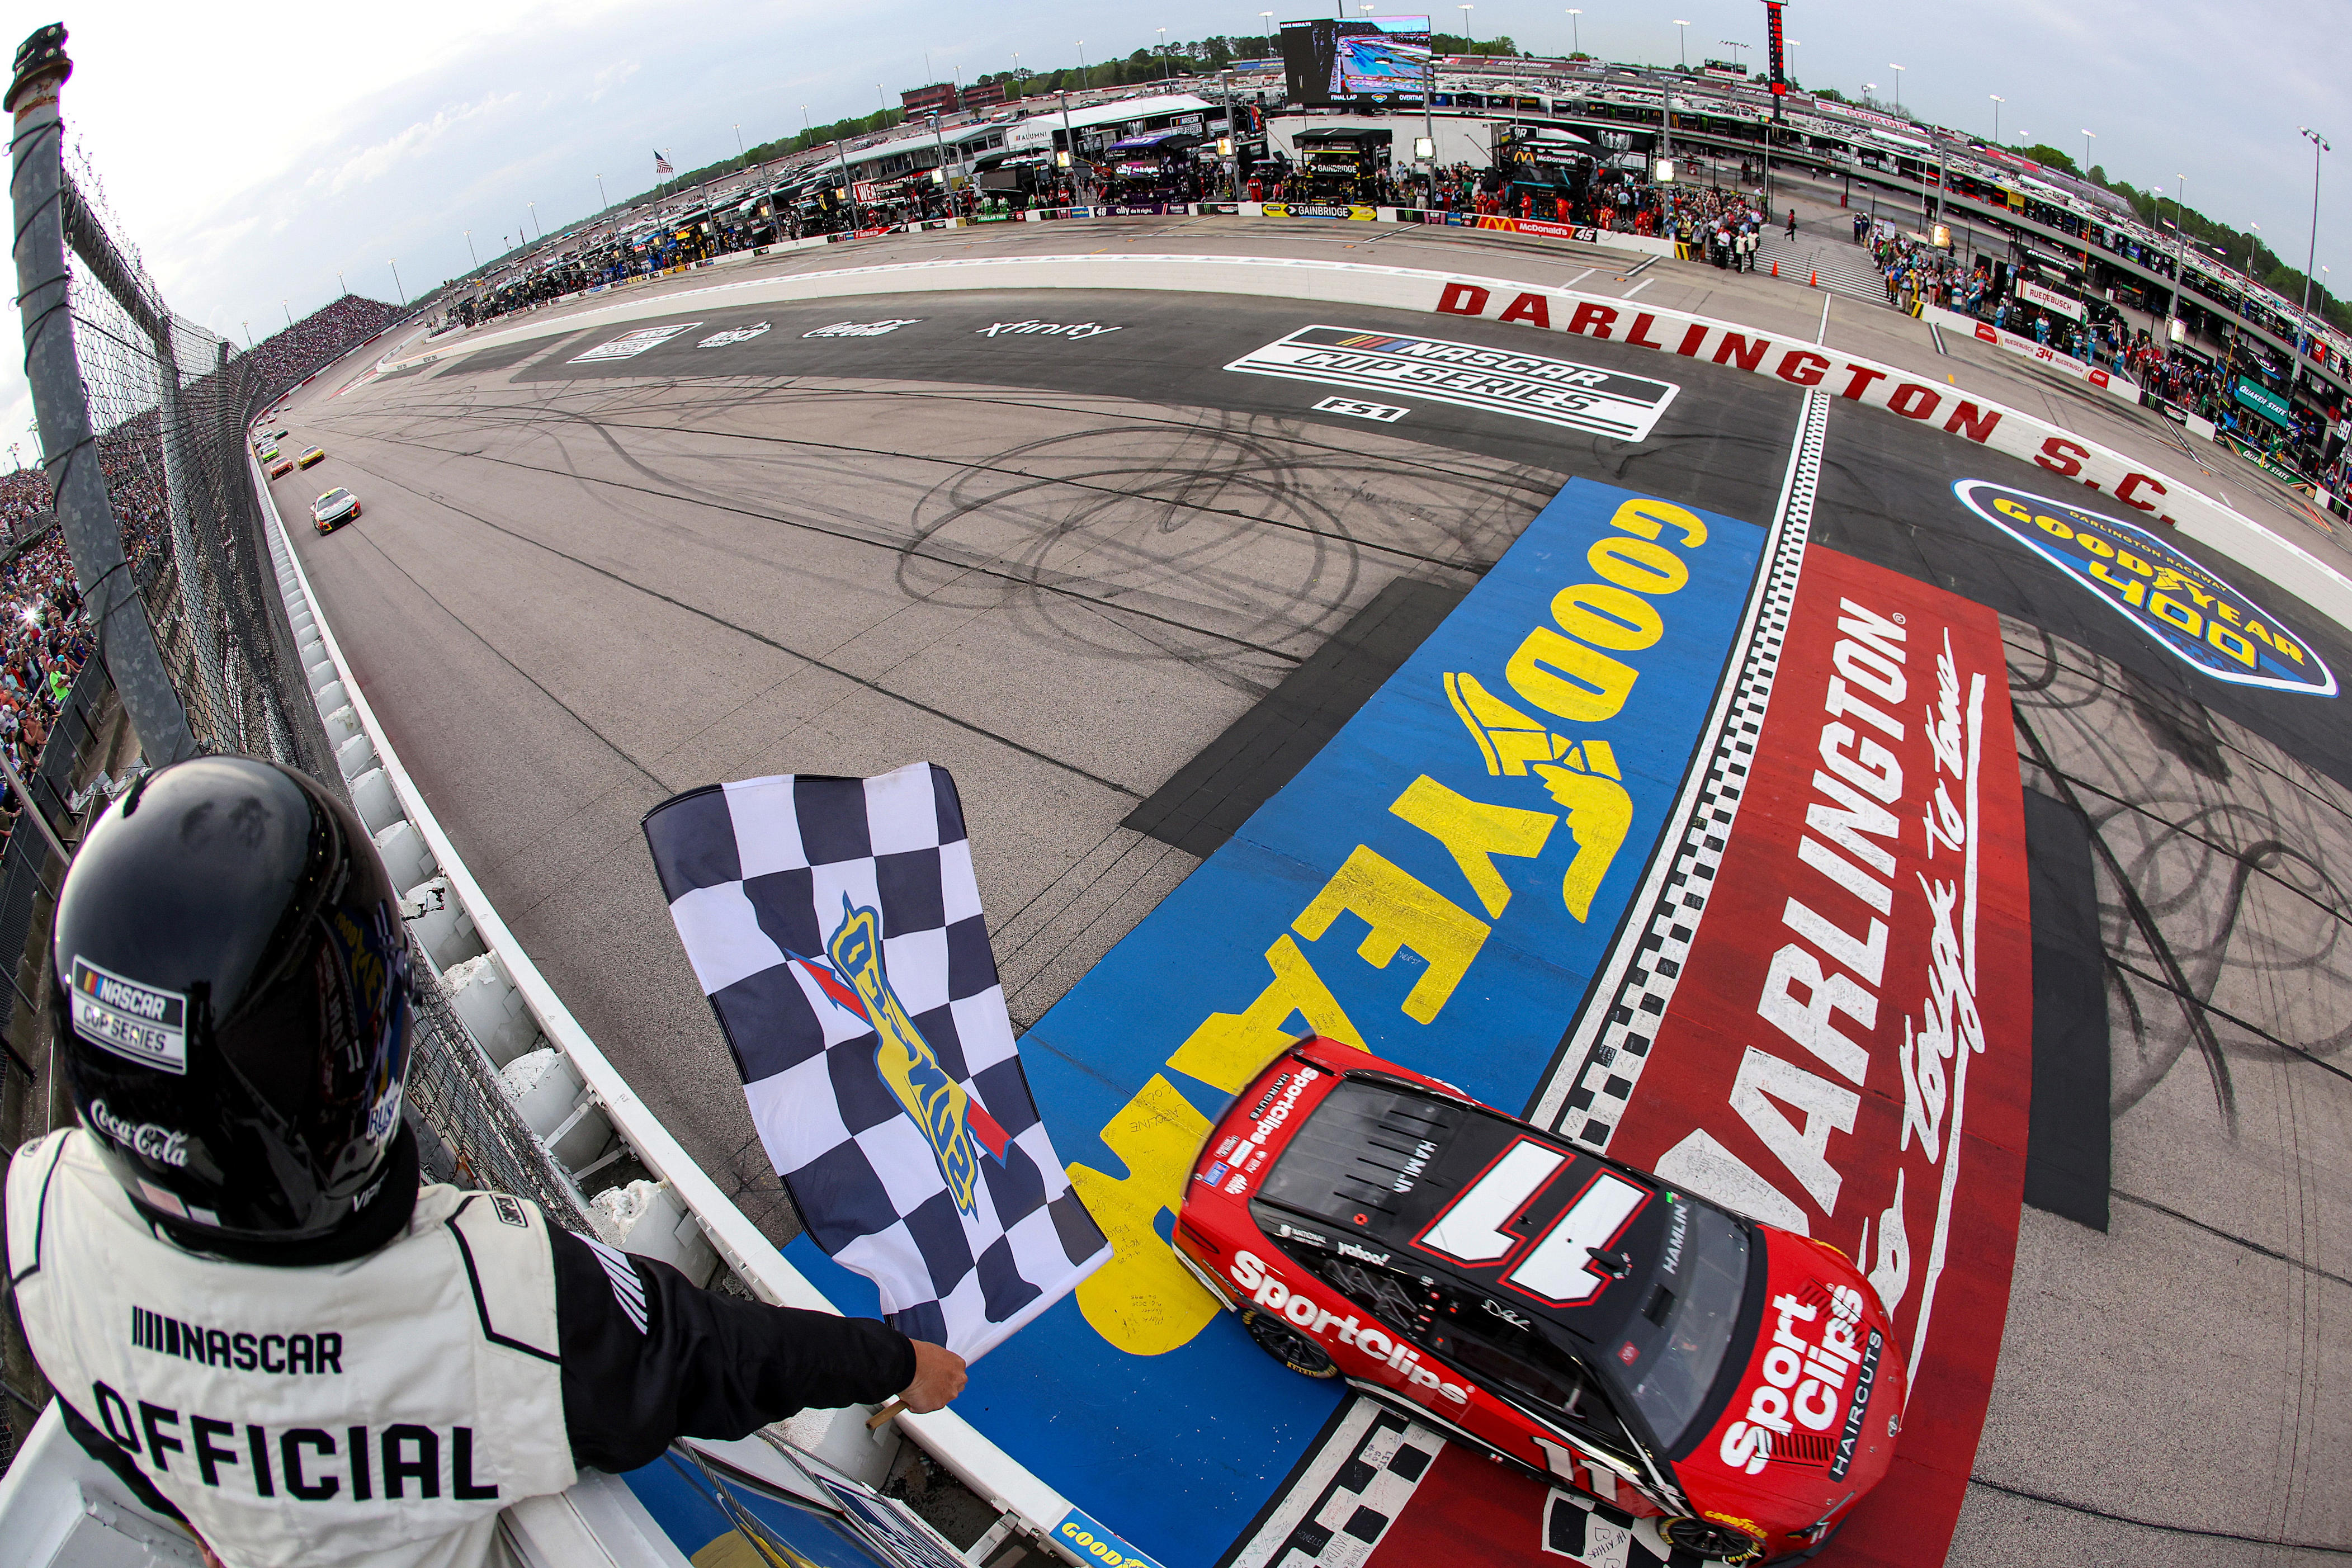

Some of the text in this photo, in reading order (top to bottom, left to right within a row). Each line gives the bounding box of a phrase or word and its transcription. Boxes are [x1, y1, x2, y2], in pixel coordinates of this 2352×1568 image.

[1022, 131, 1047, 140] ALUMNI
[1181, 116, 1199, 125] NASCAR
[1846, 110, 1910, 131] COOK OUT
[1537, 154, 1576, 166] McDonald's
[1097, 207, 1107, 216] 48
[1116, 206, 1129, 216] ally
[1298, 206, 1349, 217] GAINBRIDGE
[1519, 222, 1595, 241] McDonald's 45
[1293, 352, 1601, 410] CUP SERIES
[1398, 341, 1609, 387] NASCAR
[1435, 282, 2003, 444] DARLINGTON
[2035, 347, 2054, 362] 34
[1325, 399, 1402, 421] FS1
[2238, 385, 2287, 417] QUAKER STATE
[2269, 466, 2291, 481] STATE
[2070, 511, 2230, 593] DARLINGTON RACEWAY
[1992, 497, 2306, 667] GOODYEAR
[2088, 559, 2258, 669] 400
[100, 981, 167, 1021] NASCAR
[82, 1005, 167, 1053] CUP SERIES
[1250, 1066, 1320, 1144] SportClips
[89, 1098, 190, 1168] Coca-Cola
[1392, 1139, 1438, 1193] HAMLIN
[1414, 1136, 1650, 1305] 11
[1661, 1203, 1690, 1274] HAMLIN
[1337, 1241, 1391, 1267] yahoo!
[179, 1320, 342, 1376] NASCAR
[1230, 1249, 1468, 1406] SportClips
[1719, 1293, 1818, 1476] Sport
[1792, 1284, 1864, 1432] Clips
[1831, 1330, 1883, 1477] HAIRCUTS
[92, 1380, 499, 1501] OFFICIAL
[1533, 1435, 1618, 1503] 11
[1586, 1529, 1627, 1561] HEATHER
